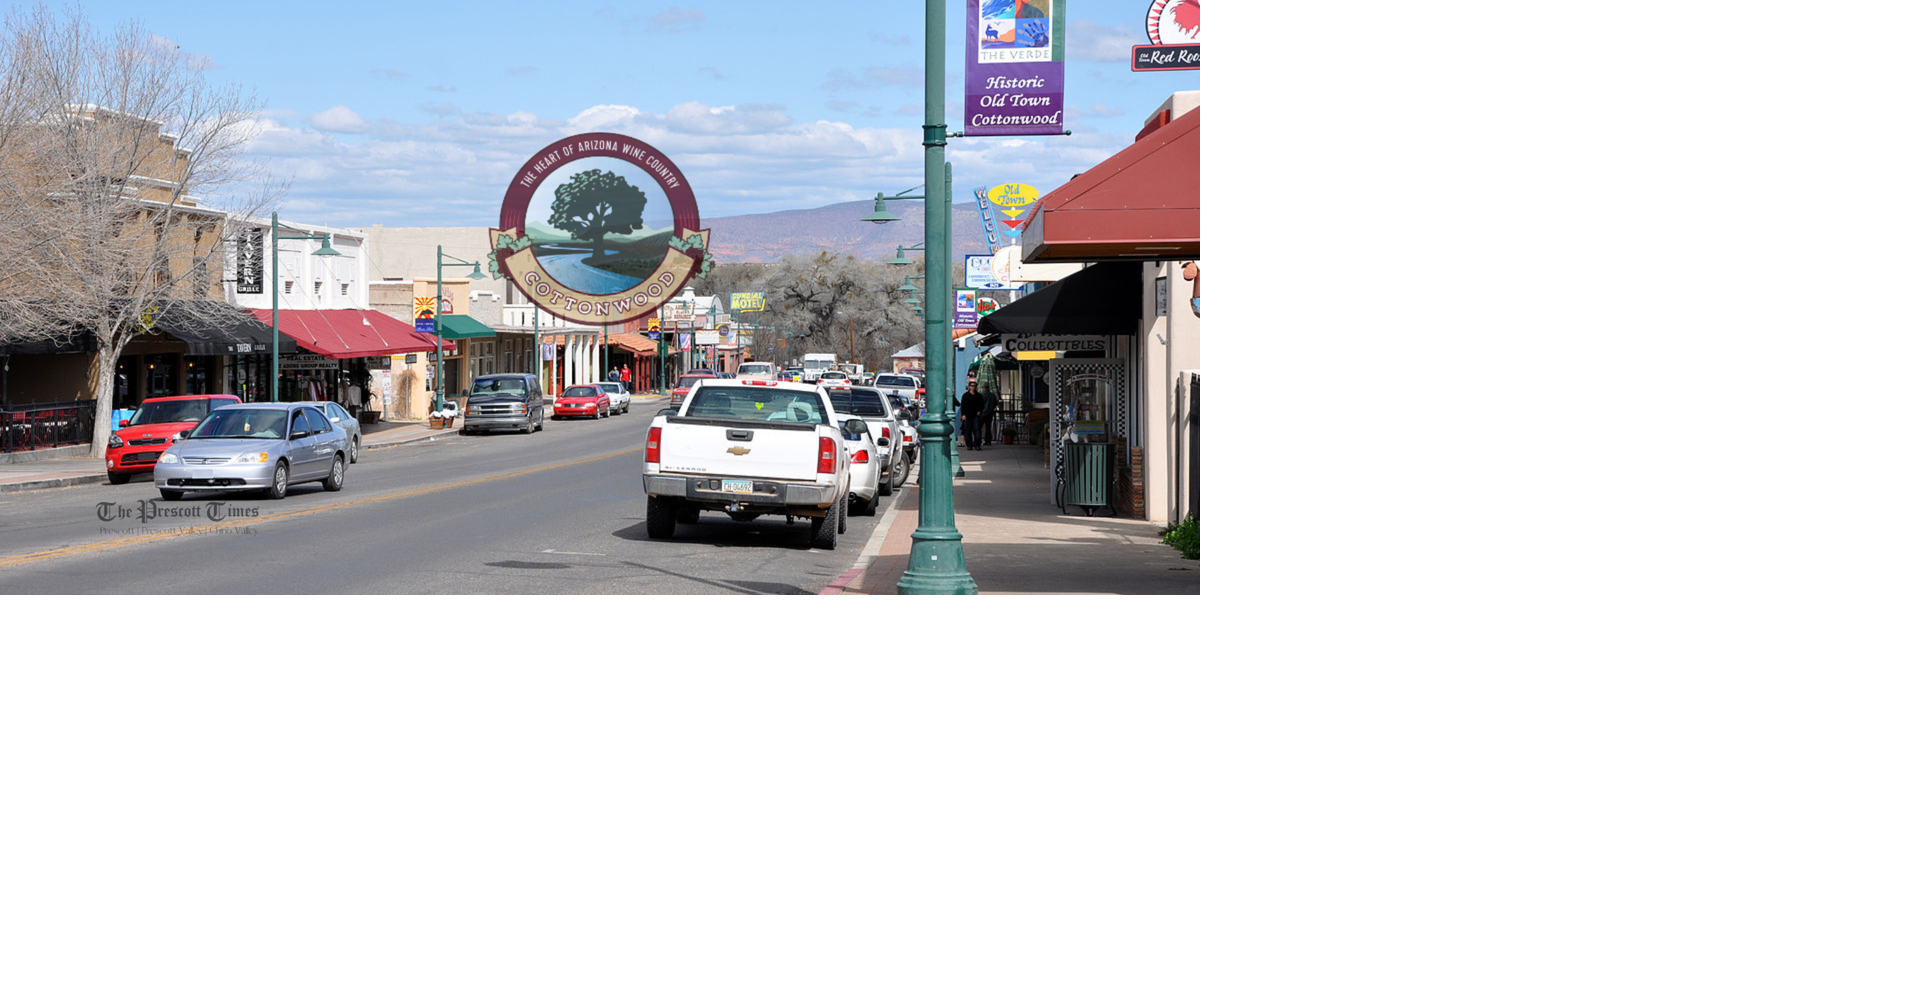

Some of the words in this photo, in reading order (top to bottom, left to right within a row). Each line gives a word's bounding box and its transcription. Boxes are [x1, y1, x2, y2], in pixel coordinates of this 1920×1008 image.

[981, 51, 1005, 60] THE
[1010, 49, 1049, 59] VERDE
[1150, 50, 1175, 64] Red
[1177, 49, 1200, 64] Roo
[985, 75, 1045, 90] Historic
[980, 93, 1009, 107] Old
[1009, 94, 1051, 107] Town
[1004, 184, 1020, 195] Old
[998, 195, 1026, 206] Town
[975, 189, 1002, 255] WELCOM
[731, 300, 761, 309] MOTEL
[1005, 339, 1106, 352] COLLECTIBLES
